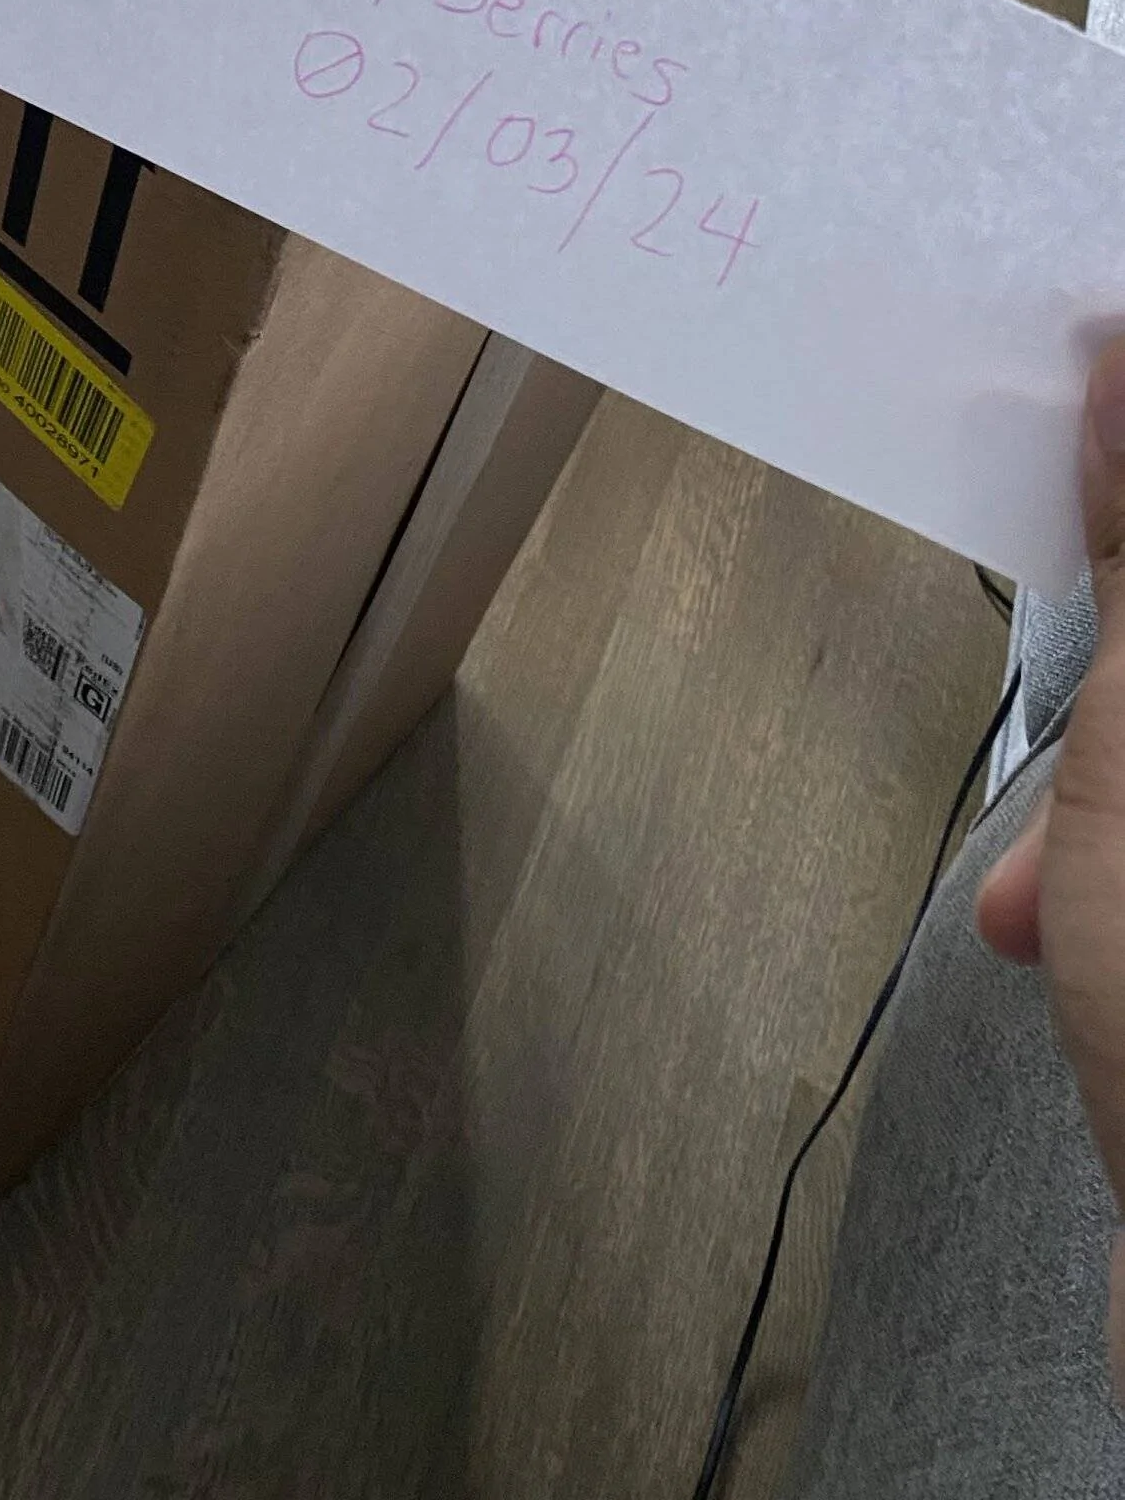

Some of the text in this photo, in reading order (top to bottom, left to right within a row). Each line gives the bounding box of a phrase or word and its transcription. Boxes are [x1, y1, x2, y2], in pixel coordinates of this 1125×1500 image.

[294, 31, 760, 287] 02/03/24
[14, 395, 100, 479] 40028971
[81, 683, 105, 715] G
